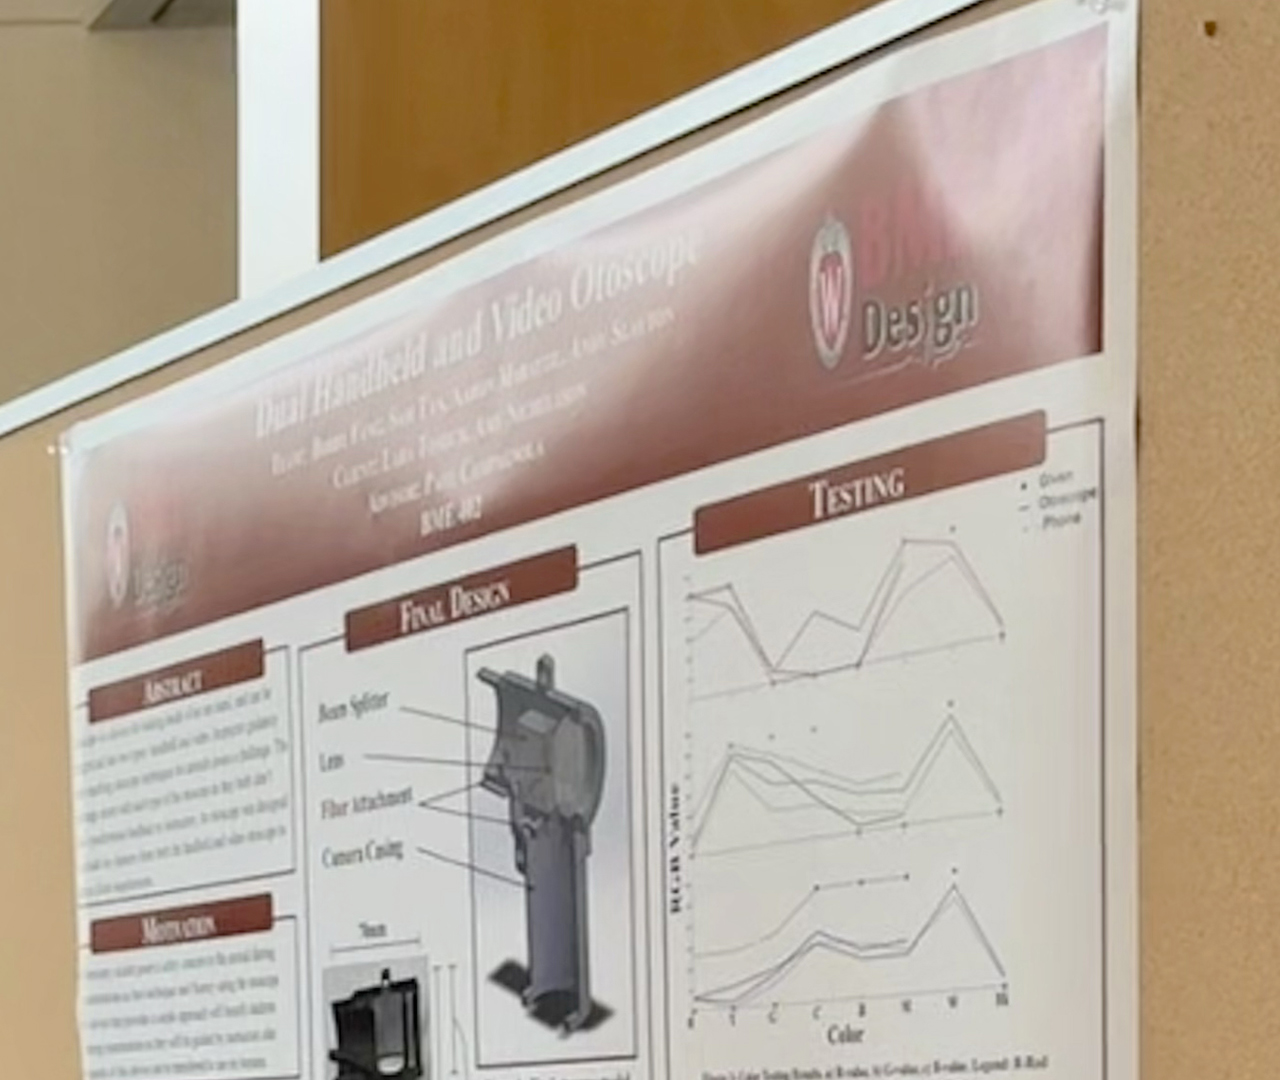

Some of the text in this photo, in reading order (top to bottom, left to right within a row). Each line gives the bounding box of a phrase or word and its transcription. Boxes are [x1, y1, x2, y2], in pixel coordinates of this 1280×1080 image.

[312, 331, 427, 416] Handheld
[432, 312, 482, 369] and
[490, 283, 563, 341] Video
[570, 230, 703, 306] Otoscope
[864, 284, 977, 362] Design
[808, 467, 906, 519] TESTING
[400, 580, 512, 635] FINAL DESIGN
[827, 1023, 865, 1045] Color
